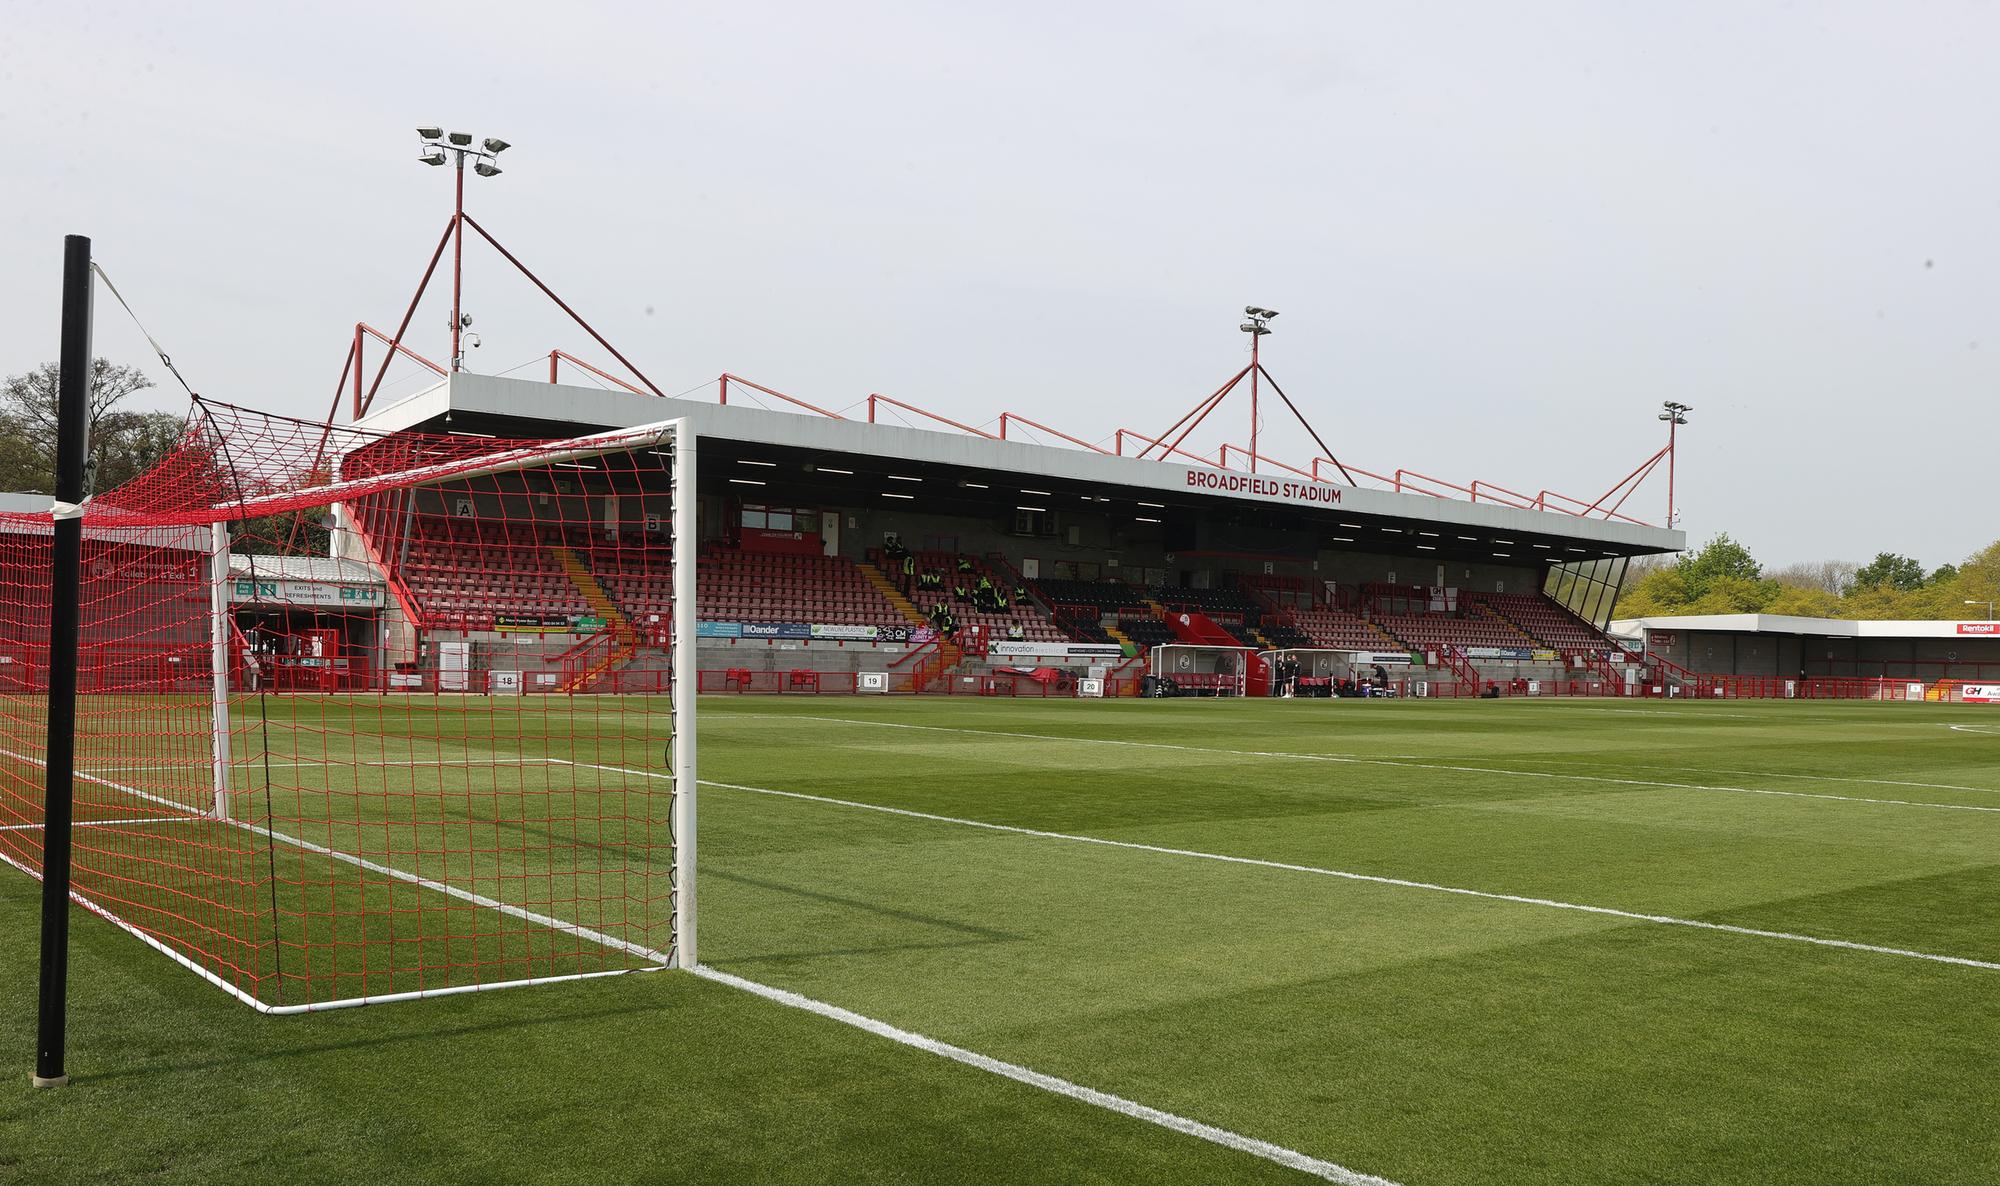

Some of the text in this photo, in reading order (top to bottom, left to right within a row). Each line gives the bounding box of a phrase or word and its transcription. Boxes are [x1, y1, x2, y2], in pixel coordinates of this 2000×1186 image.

[1187, 470, 1341, 504] BROADFIELD STADIUM
[460, 504, 470, 517] A
[648, 518, 658, 530] B
[749, 625, 780, 635] Oander
[1962, 624, 1994, 632] Rentokil
[1000, 643, 1035, 653] innovation
[502, 677, 513, 685] 18
[1965, 687, 1982, 695] GH
